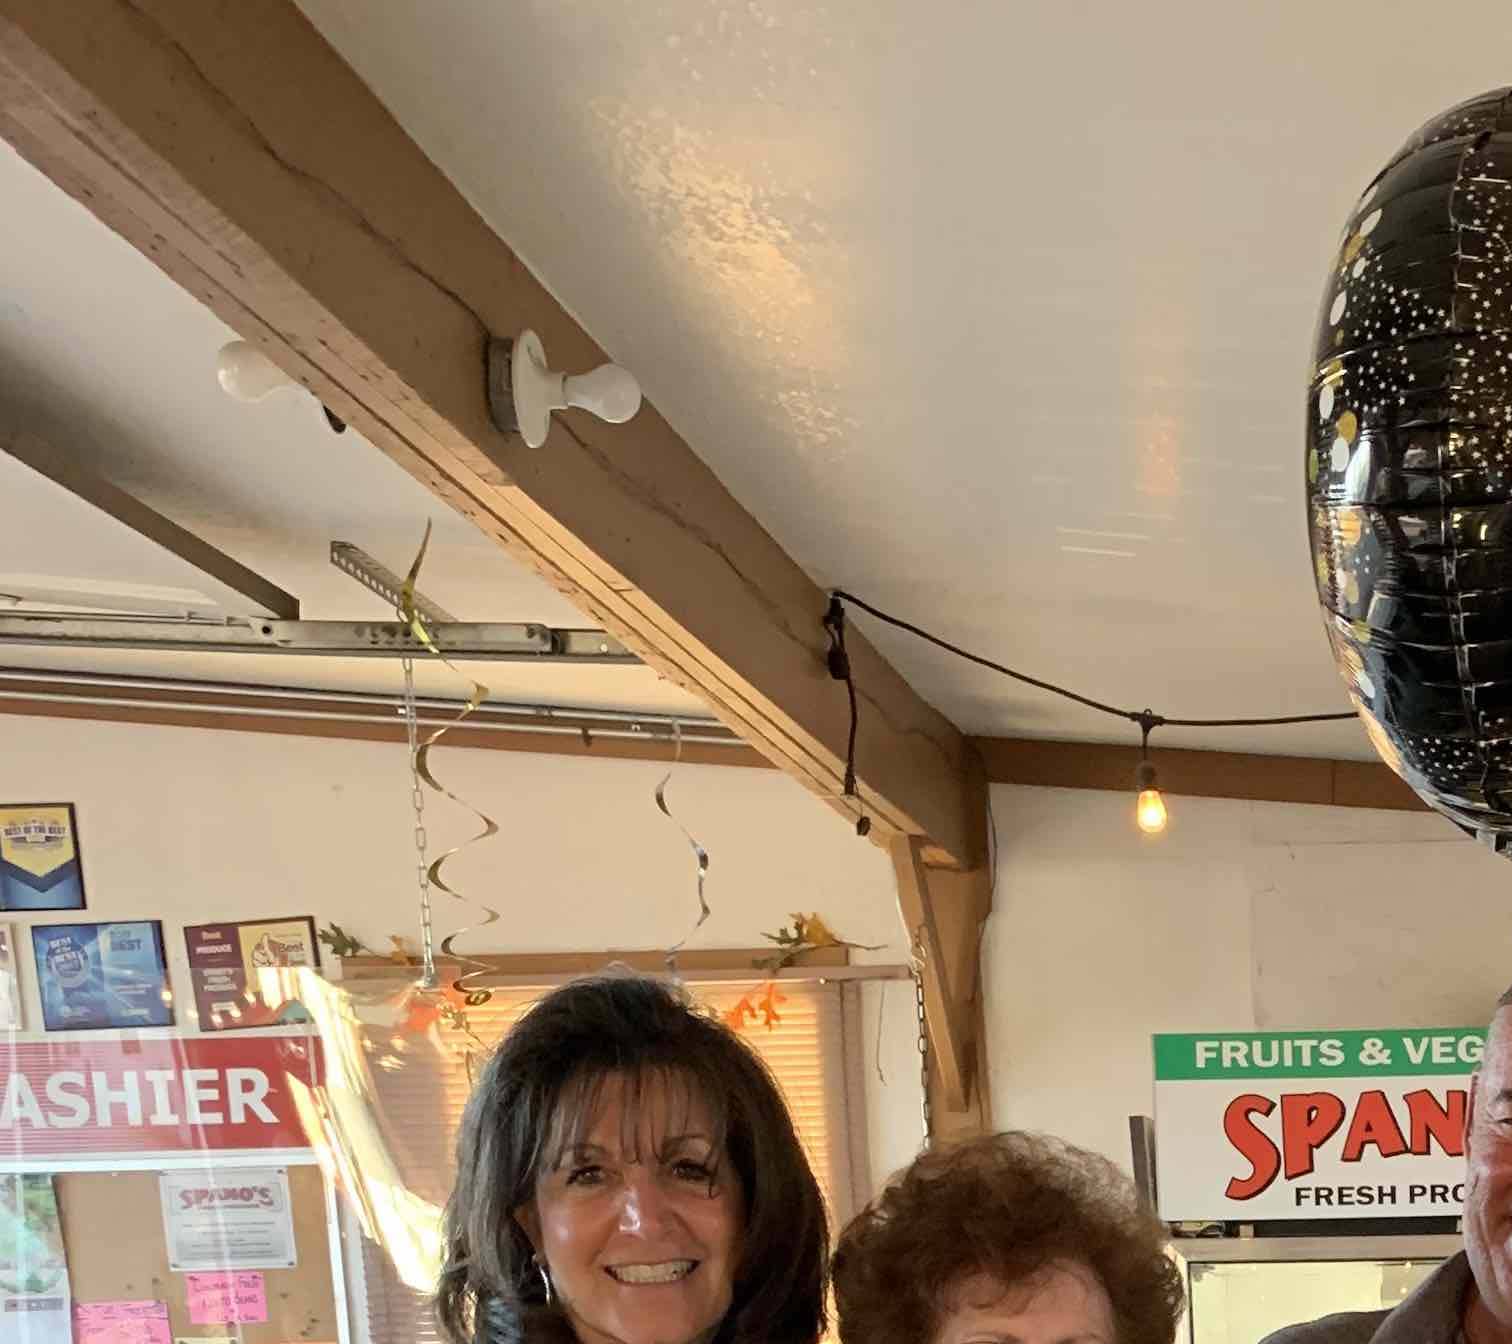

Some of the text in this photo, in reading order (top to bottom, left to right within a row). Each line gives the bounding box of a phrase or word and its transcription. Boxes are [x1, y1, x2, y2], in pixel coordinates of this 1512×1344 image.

[1194, 1034, 1486, 1069] FRUITS & VEG
[0, 1067, 281, 1129] ASHIER
[1223, 1088, 1468, 1202] SPAN
[1295, 1186, 1397, 1206] FRESH
